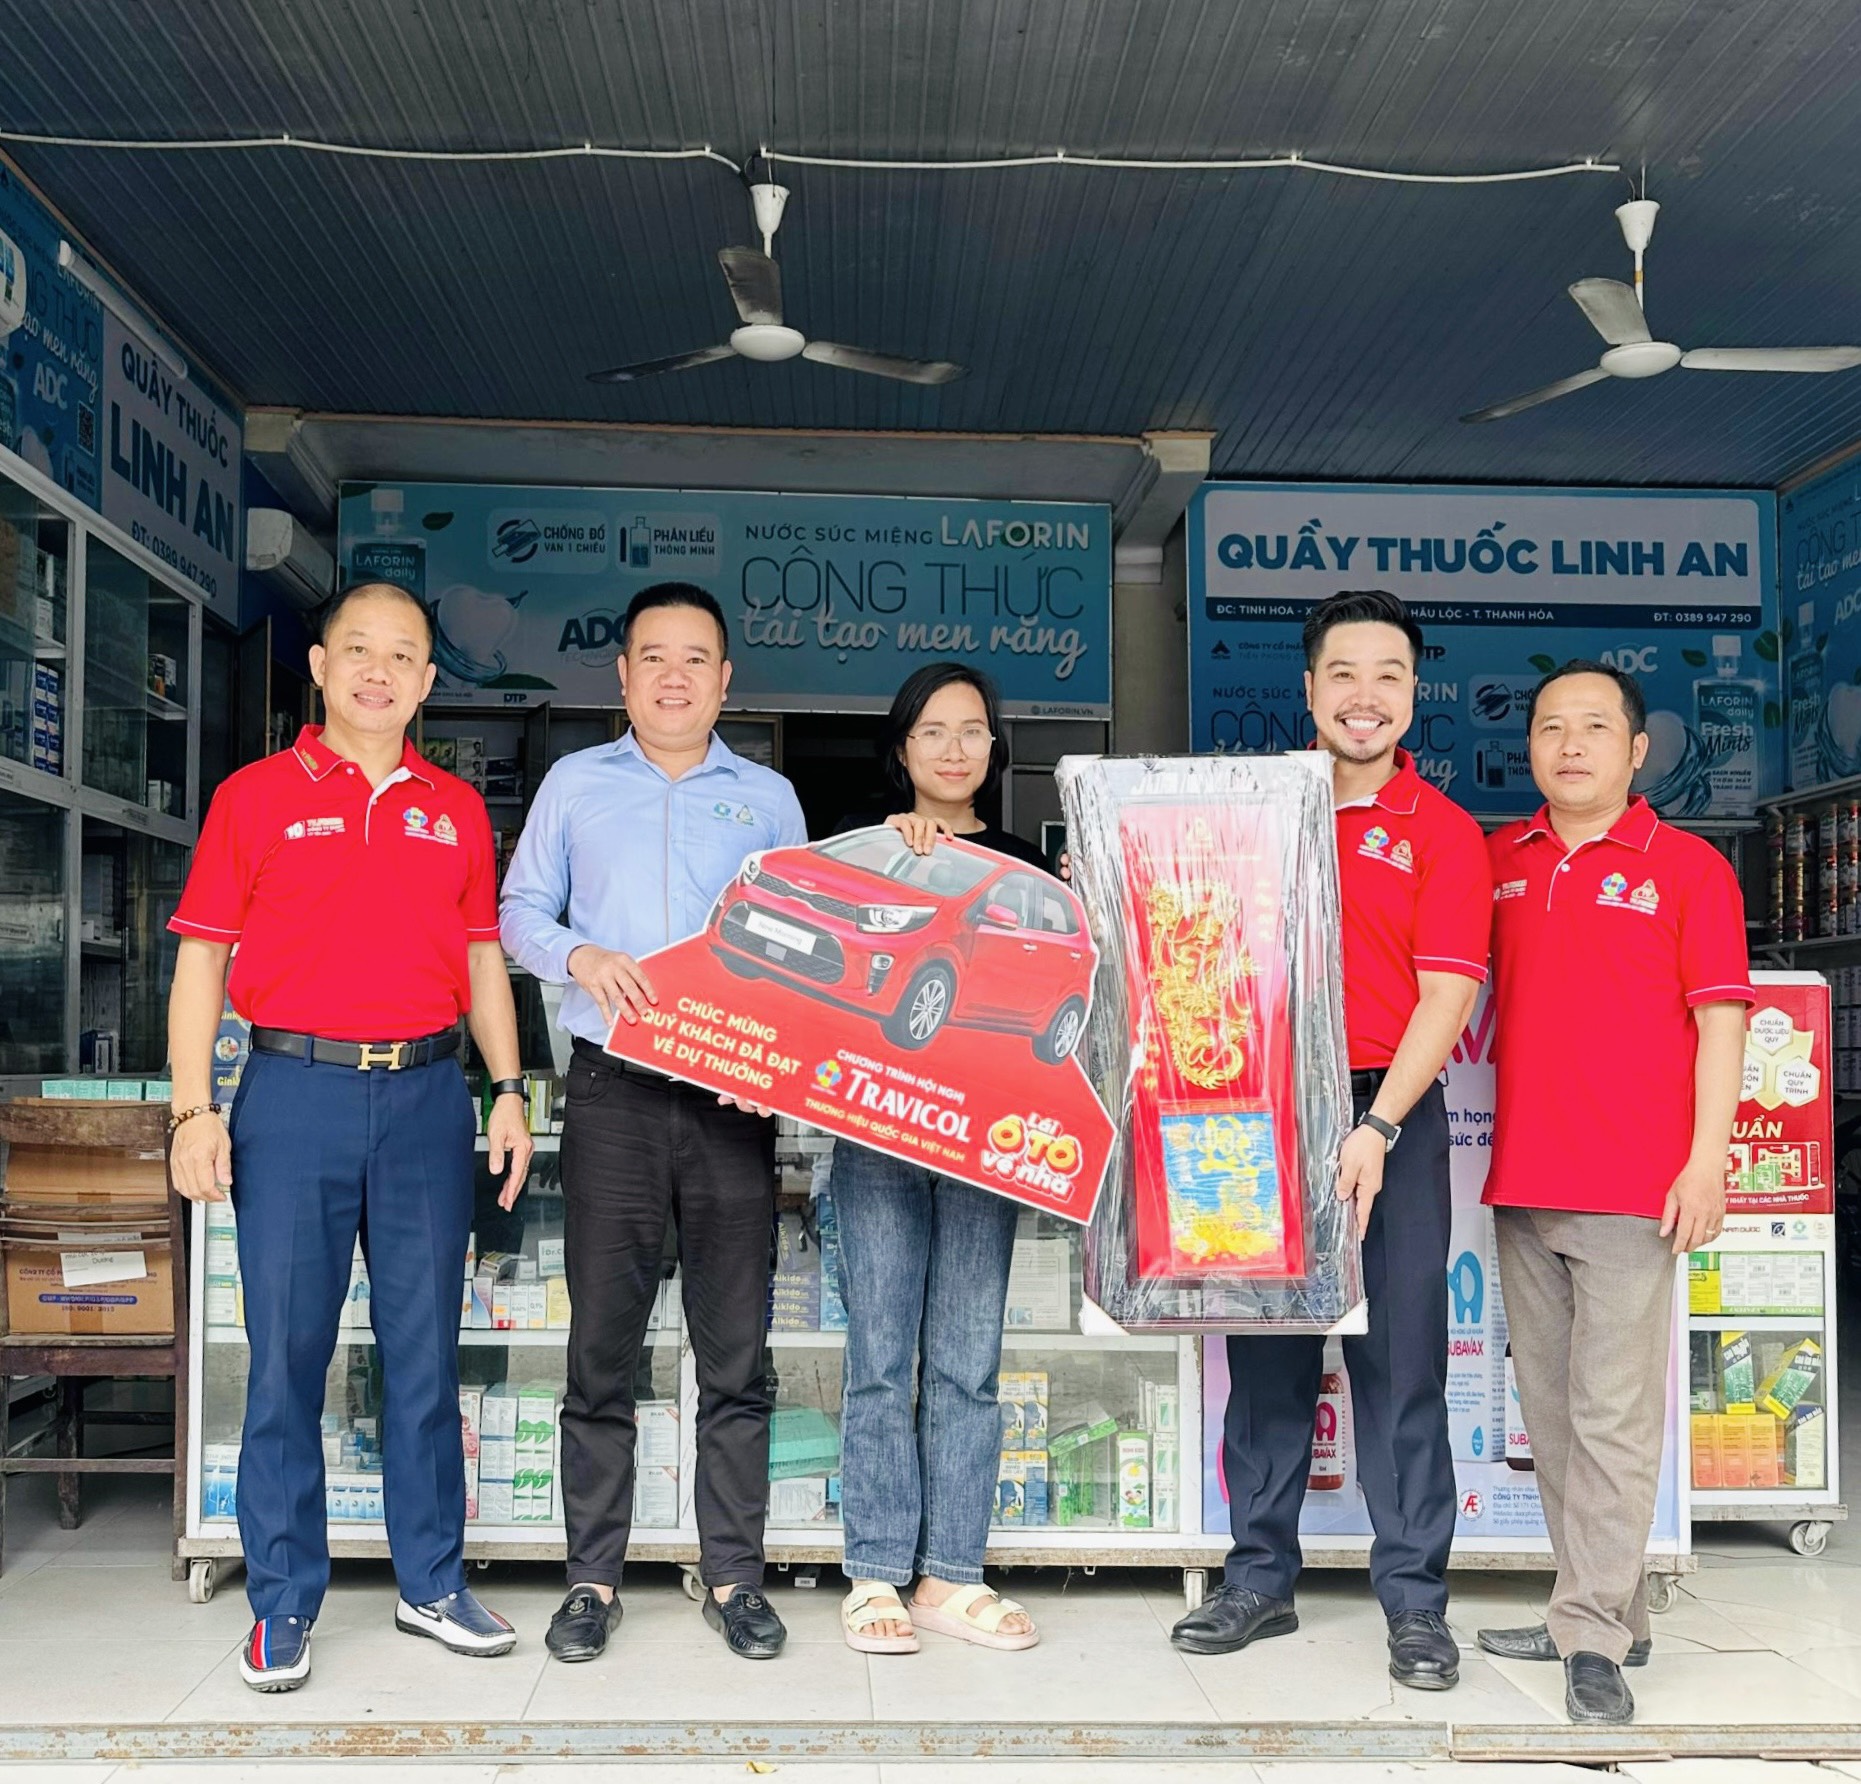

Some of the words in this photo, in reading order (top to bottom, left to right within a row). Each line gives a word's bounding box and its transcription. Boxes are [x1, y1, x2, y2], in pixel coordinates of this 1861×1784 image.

[33, 361, 69, 411] ADC
[121, 342, 173, 415] QUẦY
[176, 393, 229, 468] THUỐC
[111, 401, 188, 527] LINH
[193, 478, 234, 563] AN
[745, 522, 807, 541] NƯỚC
[815, 523, 857, 543] SÚC
[865, 525, 934, 546] MIỆNG
[941, 515, 1089, 550] LAFORIN
[543, 543, 564, 553] VAN
[654, 544, 687, 556] THÔNG
[689, 545, 715, 556] MINH
[1217, 518, 1360, 572] QUẦY
[1367, 520, 1540, 575] THUỐC
[1551, 539, 1665, 577] LINH
[1676, 541, 1749, 577] AN
[152, 536, 178, 571] 0389
[180, 556, 198, 583] 947
[355, 554, 416, 567] LAFORIN
[384, 566, 416, 579] daily
[741, 545, 907, 614] CÔNG
[924, 551, 1084, 620] THỨC
[1216, 604, 1237, 615] ĐC:
[1438, 606, 1462, 620] LỘC
[1485, 609, 1526, 620] THANH
[1528, 607, 1554, 620] HÓA
[1653, 612, 1673, 623] ĐT:
[1675, 612, 1704, 623] 0389
[1706, 613, 1728, 623] 947
[1730, 613, 1752, 623] 290
[738, 598, 805, 648] tái
[811, 601, 888, 664] tạo
[897, 621, 980, 653] men
[989, 614, 1088, 680] răng
[503, 693, 528, 703] DTP
[1212, 685, 1257, 699] NƯỚC
[1261, 685, 1291, 700] SÚC
[1701, 696, 1754, 707] LAFORIN
[1727, 706, 1754, 720] daily
[1701, 721, 1755, 737] Fresh
[1704, 733, 1755, 760] Mints
[677, 997, 725, 1025] CHÚC
[726, 1013, 778, 1042] MỪNG
[641, 1009, 678, 1030] QUÝ
[677, 1020, 737, 1053] KHÁCH
[738, 1041, 765, 1063] ĐÃ
[766, 1052, 802, 1076] ĐẠT
[653, 1034, 676, 1055] VÉ
[675, 1042, 704, 1067] DỰ
[703, 1052, 774, 1089] THƯỞNG
[836, 1049, 884, 1073] CHƯƠNG
[885, 1066, 916, 1085] TRÌNH
[916, 1077, 937, 1094] HỘI
[937, 1086, 966, 1106] NGHỊ
[1787, 1078, 1804, 1087] QUY
[845, 1068, 972, 1143] TRAVICOL
[805, 1097, 846, 1120] THƯƠNG
[846, 1113, 869, 1128] HIỆU
[869, 1121, 901, 1139] QUỐC
[901, 1132, 919, 1147] GIA
[920, 1138, 942, 1155] VIỆT
[942, 1148, 966, 1163] NAM
[1027, 1112, 1062, 1135] Lái
[1732, 1115, 1784, 1139] UẨN
[981, 1149, 1022, 1179] về
[1016, 1163, 1074, 1199] nhà
[777, 1222, 789, 1252] Aikido
[772, 1274, 802, 1283] Aikido
[772, 1288, 801, 1298] Aikido
[771, 1302, 801, 1312] Aikido
[771, 1316, 800, 1326] Aikido
[1446, 1337, 1485, 1357] UBAVAX
[1492, 1492, 1511, 1501] CÔNG
